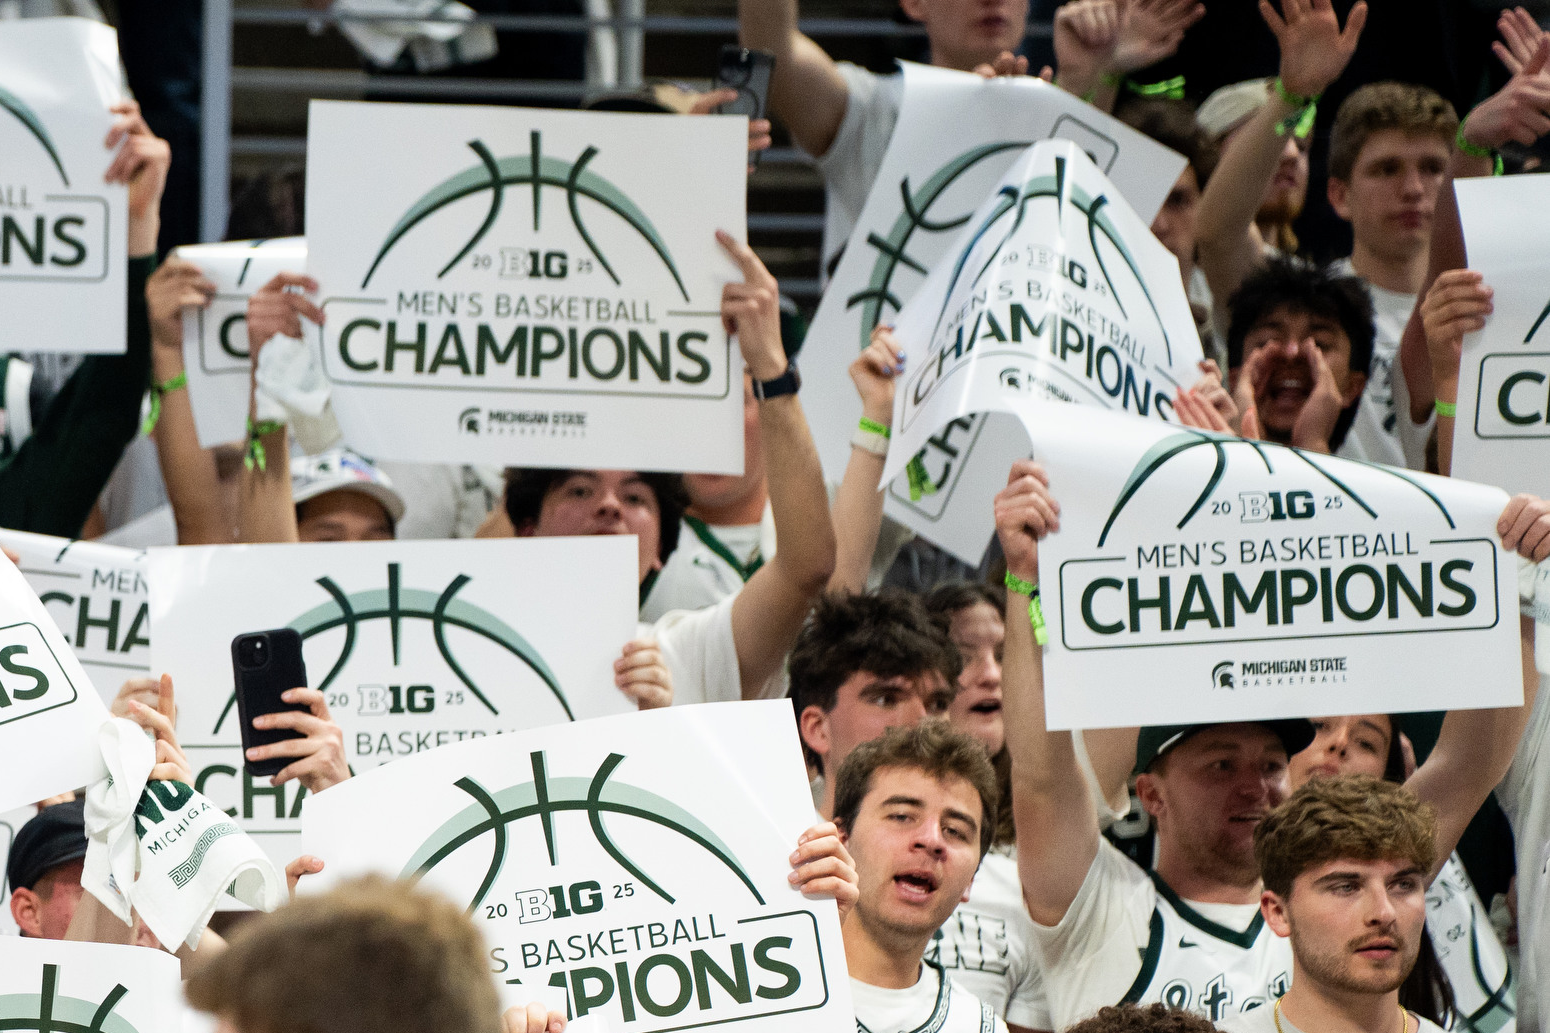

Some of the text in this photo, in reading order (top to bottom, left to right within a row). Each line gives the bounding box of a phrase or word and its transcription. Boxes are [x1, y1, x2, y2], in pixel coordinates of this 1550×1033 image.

[472, 254, 493, 270] 20
[577, 258, 594, 273] 25
[397, 291, 657, 323] MEN'S BASKETBALL
[338, 317, 713, 384] CHAMPIONS
[1211, 500, 1232, 515] 20
[1324, 495, 1344, 510] 25
[1137, 532, 1420, 569] MEN'S BASKETBALL
[1080, 559, 1477, 636] CHAMPIONS
[1241, 656, 1348, 677] MICHIGAN STATE
[1241, 674, 1348, 688] BASKETBALL
[329, 693, 349, 708] 20
[445, 691, 465, 706] 25
[147, 801, 215, 855] MICHIGA
[486, 903, 508, 920] 20
[612, 882, 636, 900] 25
[521, 913, 726, 969] BASKETBALL
